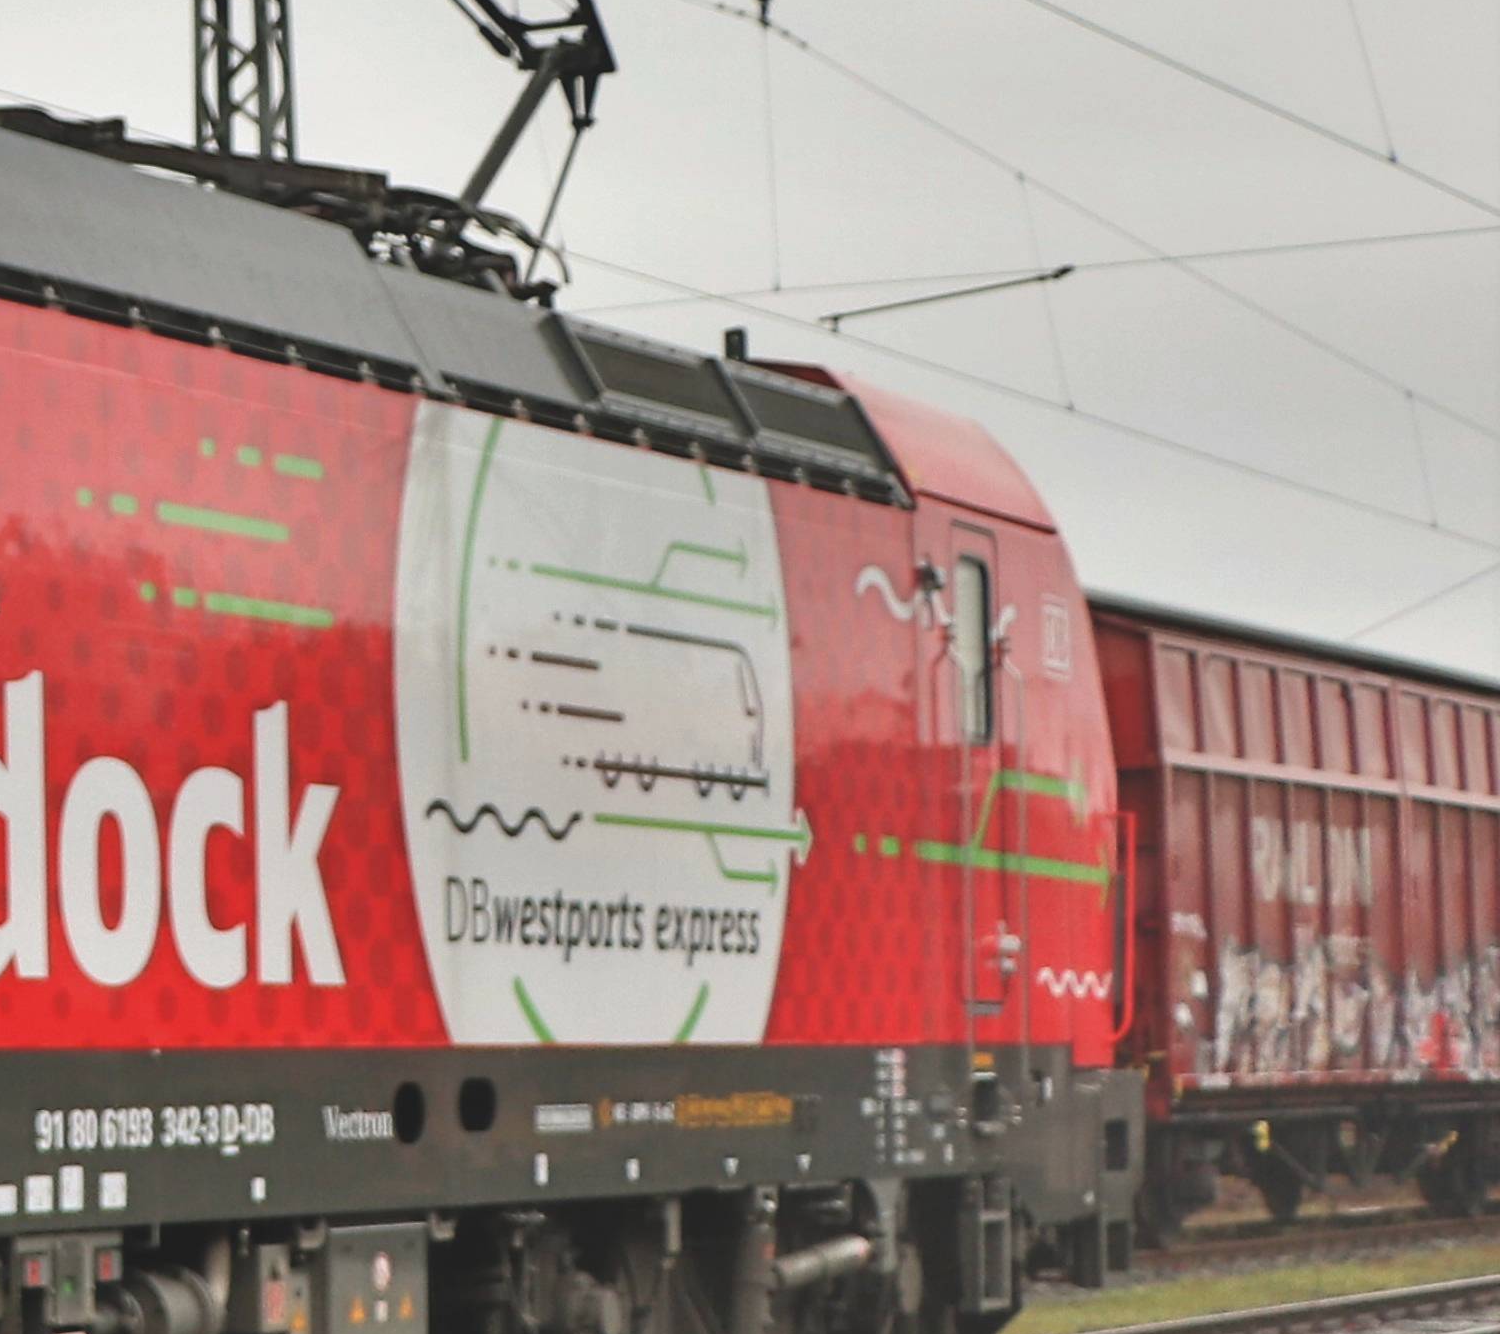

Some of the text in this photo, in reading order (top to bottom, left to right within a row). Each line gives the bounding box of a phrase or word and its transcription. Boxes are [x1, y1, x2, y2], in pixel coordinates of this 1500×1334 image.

[654, 904, 761, 967] express
[35, 1109, 65, 1151] 91
[68, 1108, 99, 1150] 80
[101, 1106, 154, 1149] 6193
[322, 1105, 395, 1141] Vectron
